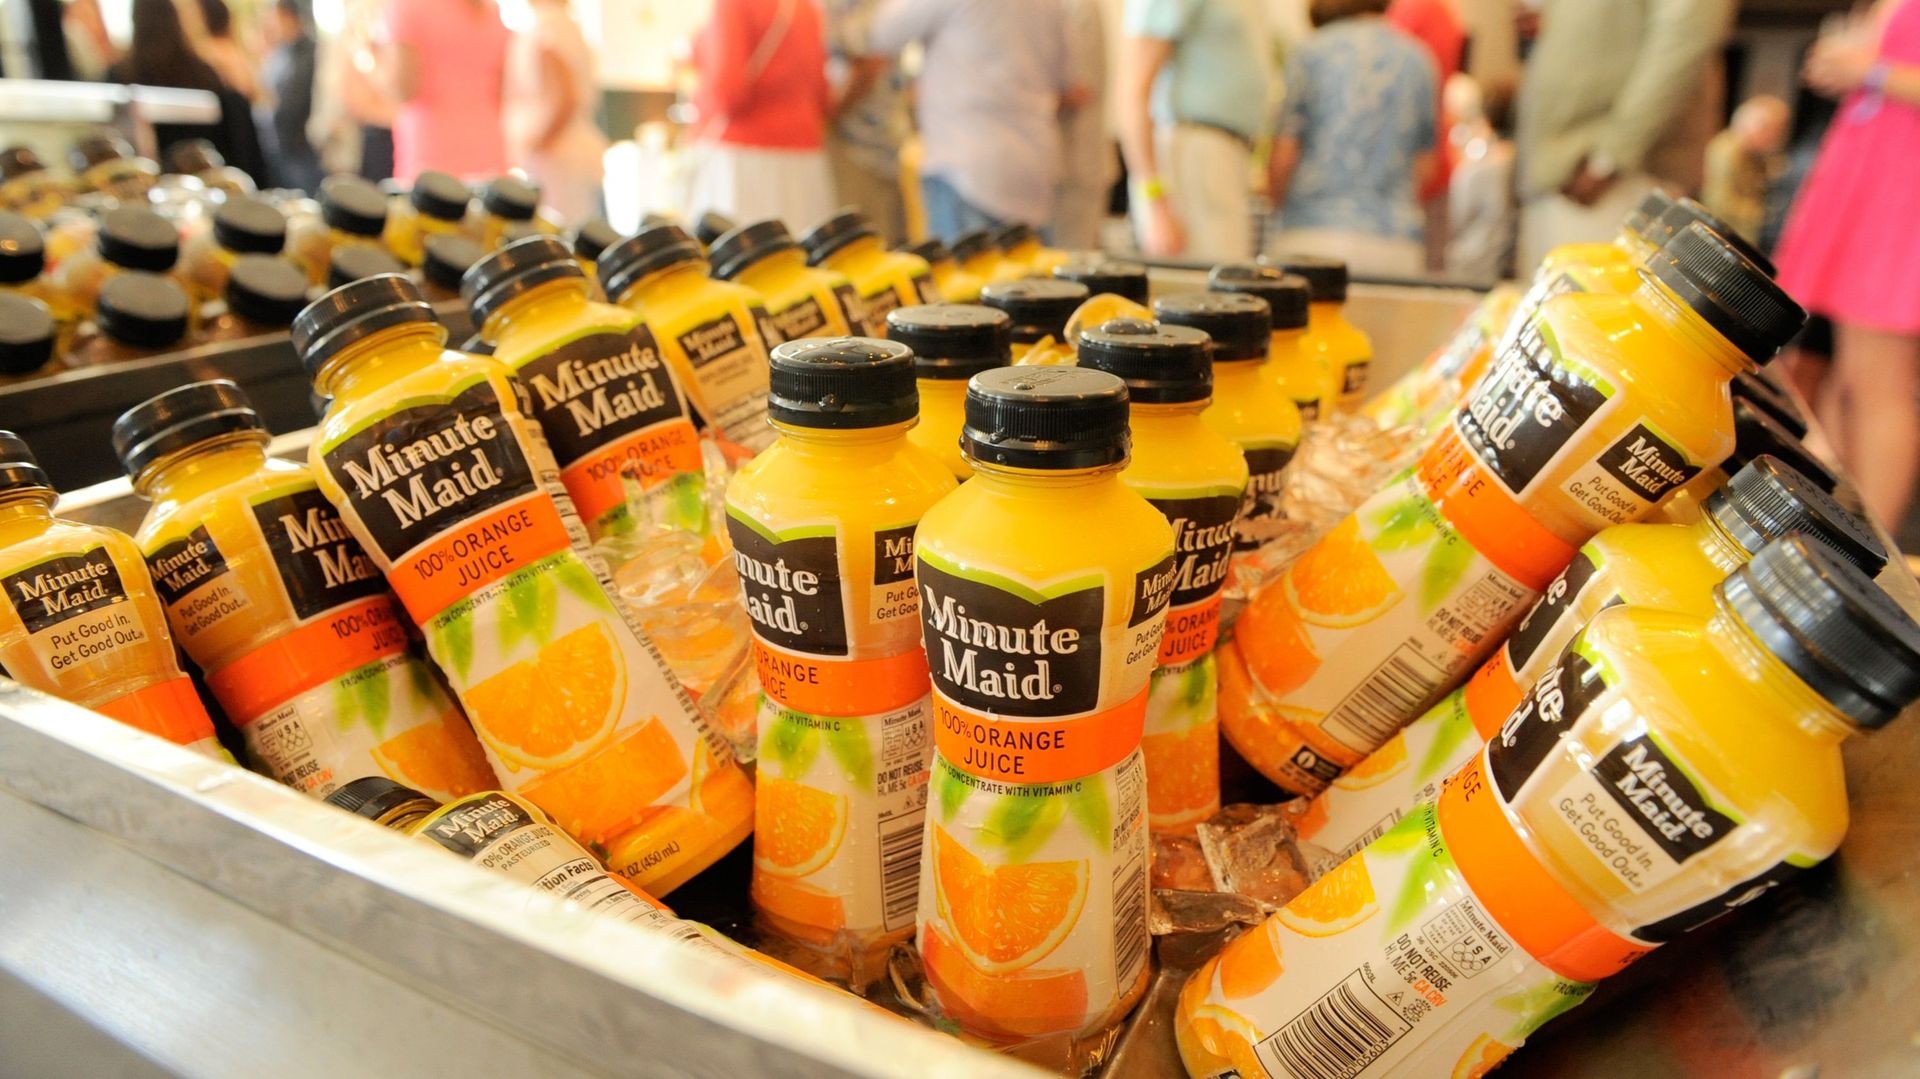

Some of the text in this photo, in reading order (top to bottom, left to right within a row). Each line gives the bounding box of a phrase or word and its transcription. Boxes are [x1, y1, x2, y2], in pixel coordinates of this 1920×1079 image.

[529, 342, 659, 411] Minute
[565, 371, 664, 437] Maid
[1469, 394, 1524, 451] aid
[342, 413, 498, 500] Minute
[1618, 456, 1669, 495] Maid
[1626, 435, 1686, 485] Minute
[381, 448, 502, 530] Maid
[1569, 481, 1589, 501] Get
[1586, 496, 1615, 518] Good
[1588, 476, 1608, 496] Put
[1605, 490, 1634, 511] Good
[279, 507, 351, 553] Min
[413, 547, 453, 581] 100%
[452, 509, 534, 558] ORANGE
[149, 539, 208, 580] Minute
[164, 557, 211, 592] Maid
[314, 545, 372, 588] Ma
[458, 544, 515, 587] JUICE
[734, 550, 819, 596] nute
[16, 562, 109, 602] Minute
[40, 579, 107, 617] Maid
[193, 590, 219, 611] Good
[508, 573, 529, 589] WITH
[886, 586, 919, 604] Put Go
[197, 608, 222, 629] Good
[876, 602, 919, 620] Get Goo
[923, 584, 1080, 655] Minute
[51, 613, 131, 649] Put Good In.
[51, 628, 141, 669] Get Good Out.
[1135, 630, 1149, 647] Put
[1164, 628, 1208, 657] JUICE
[940, 637, 1055, 700] Maid
[1126, 650, 1142, 665] Get
[761, 670, 788, 700] UICE
[795, 715, 832, 732] VITAMIN
[833, 720, 841, 732] C
[939, 706, 1066, 751] 100% ORANGE
[963, 746, 1025, 775] JUICE
[947, 765, 1003, 795] CONCENTRATE
[1004, 785, 1030, 798] WITH
[1032, 783, 1074, 798] VITAMIN
[1075, 782, 1083, 792] C
[1621, 743, 1714, 839] Minute
[437, 799, 511, 838] Minute
[462, 808, 519, 844] Maid
[1615, 771, 1687, 842] Maid
[480, 852, 504, 869] 0%
[498, 831, 535, 857] ORANGE
[1433, 847, 1443, 857] C
[1559, 798, 1639, 886] Get Good Out.
[1580, 793, 1653, 872] Put Good In.
[500, 839, 552, 872] PASTEURIZED
[565, 860, 594, 878] Facts
[627, 862, 642, 877] OZ
[641, 850, 662, 871] (450
[662, 840, 681, 859] mL)
[1461, 900, 1509, 955] Minute Maid
[1397, 933, 1453, 992] DO NOT REUSE
[1424, 947, 1439, 961] USC
[1390, 956, 1411, 976] ME
[1412, 979, 1430, 994] CA
[1424, 989, 1448, 1008] CRV
[1355, 1039, 1390, 1068] 05603
